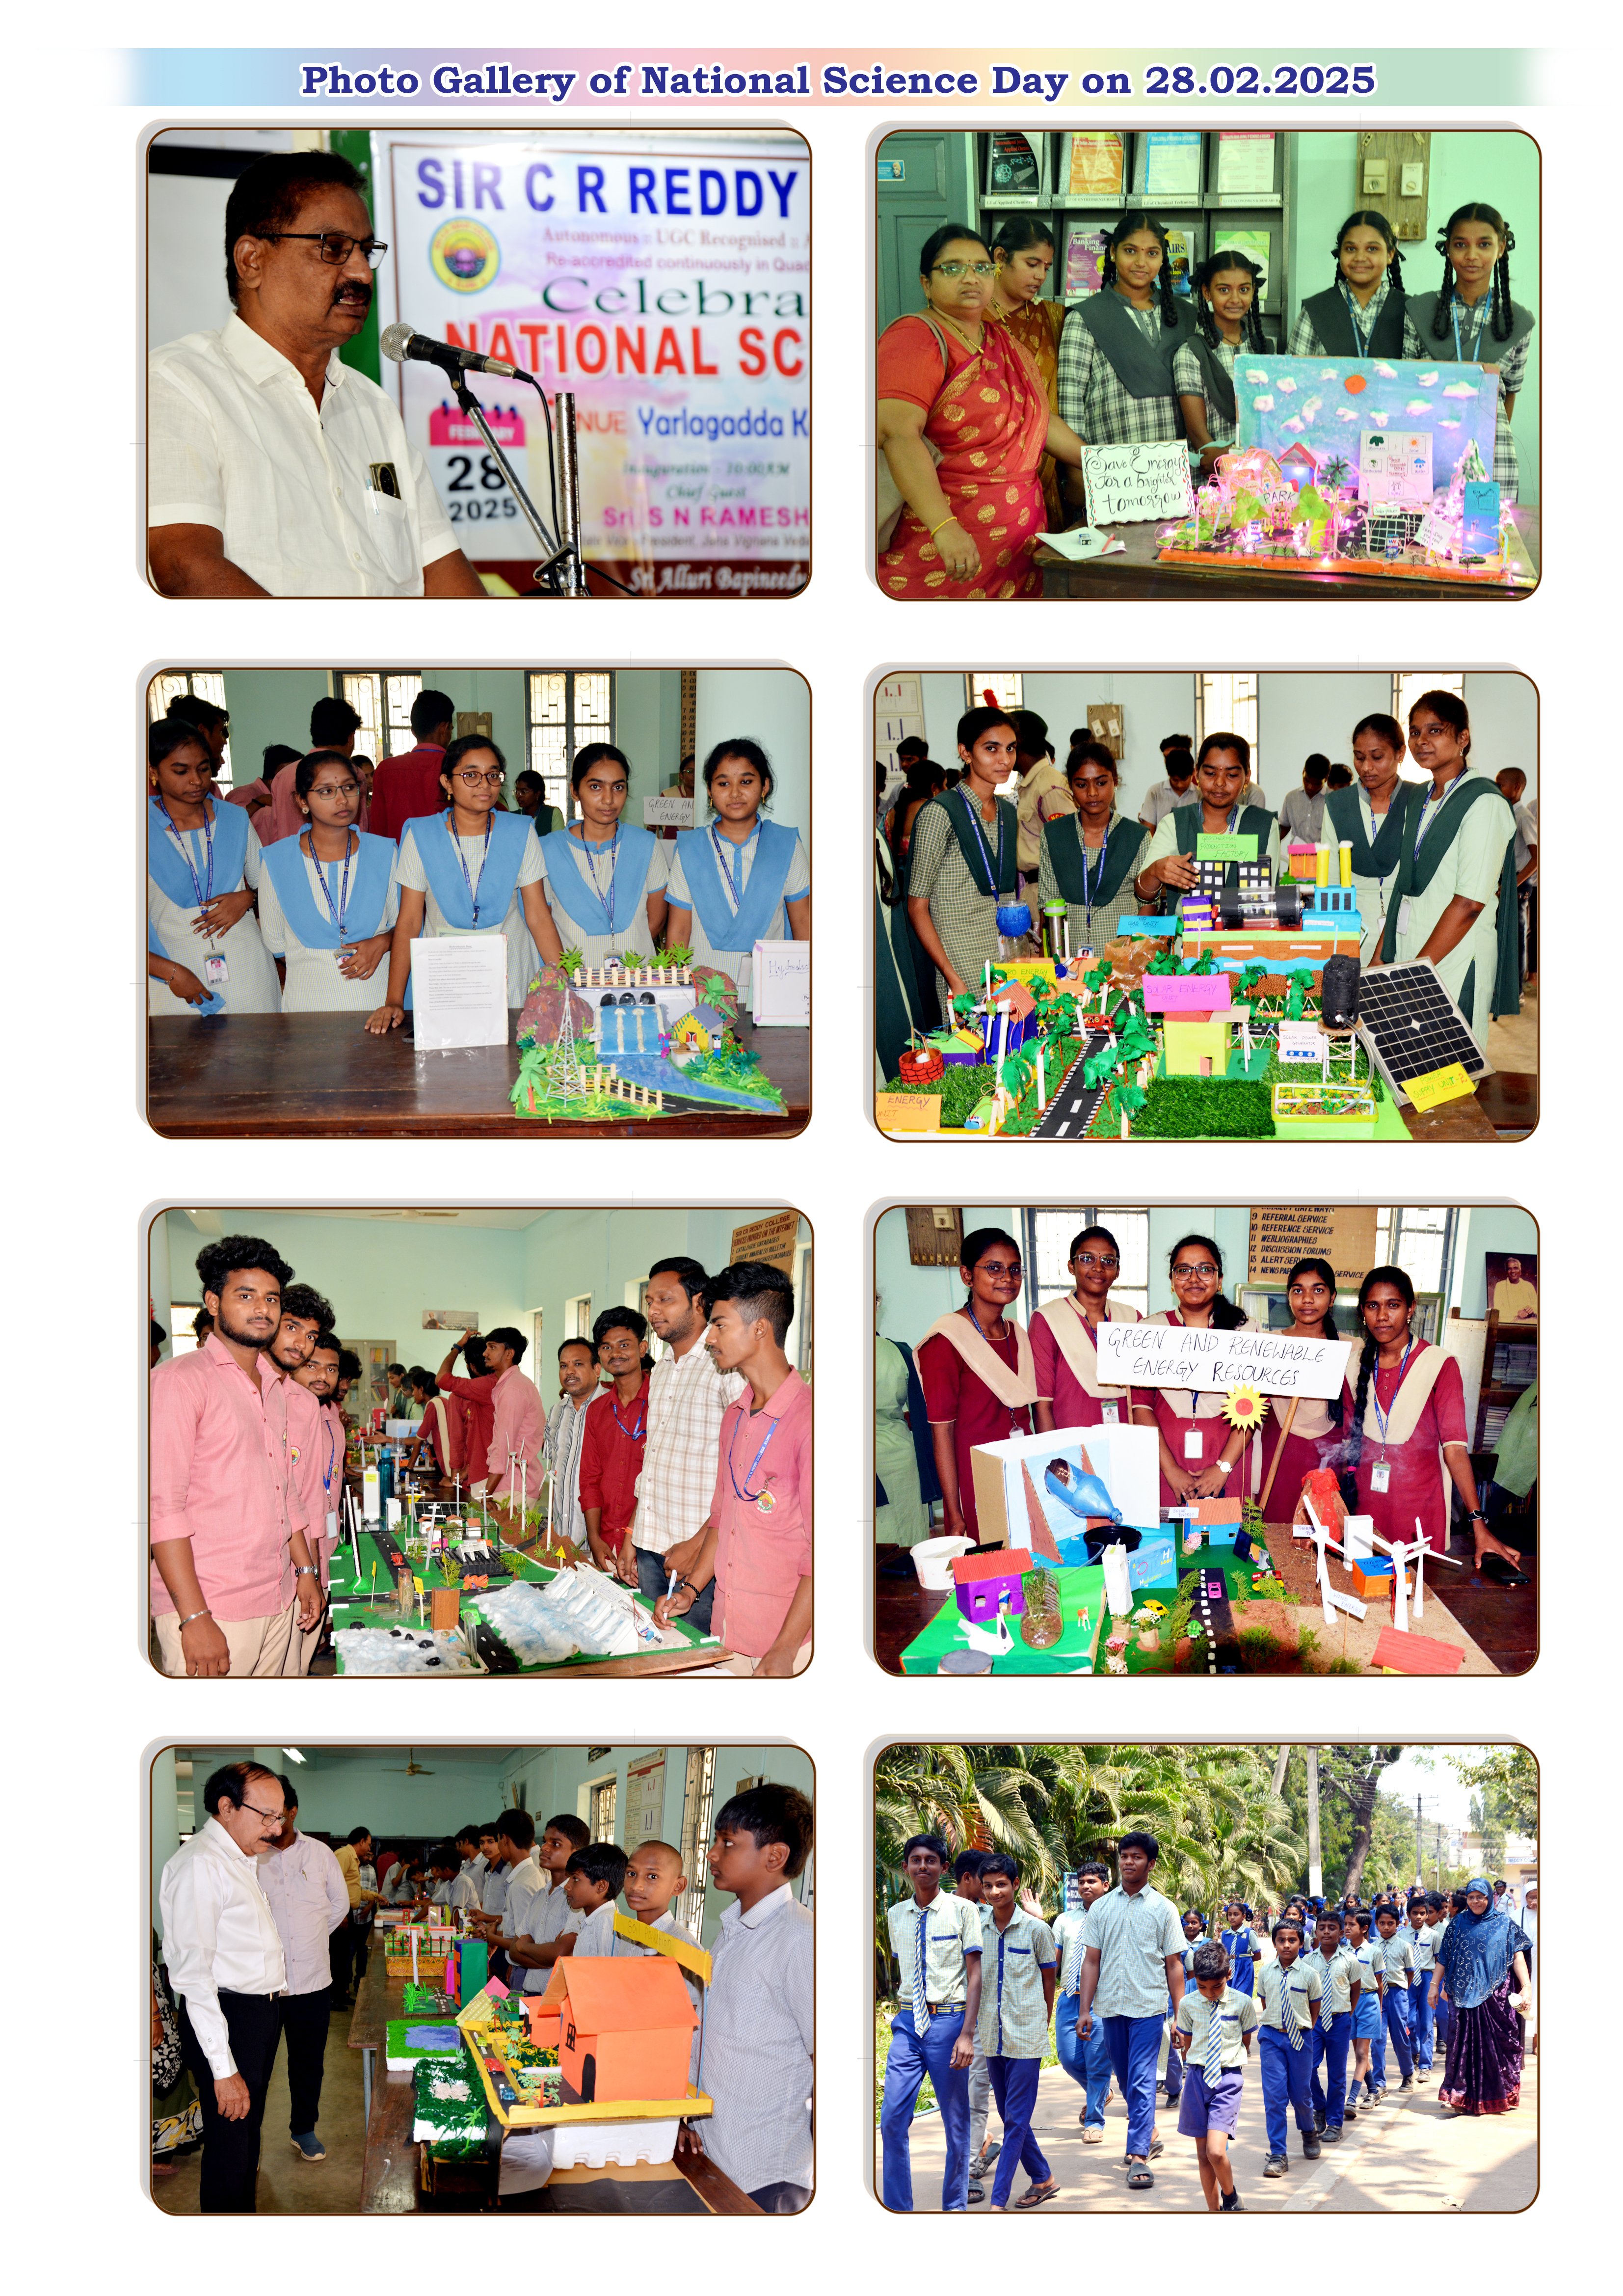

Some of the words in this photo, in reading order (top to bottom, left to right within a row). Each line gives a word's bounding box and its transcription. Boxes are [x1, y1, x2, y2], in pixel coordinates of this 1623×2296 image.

[417, 157, 505, 210] SIR
[525, 163, 555, 212] C
[577, 165, 608, 214] R
[629, 166, 798, 219] REDDY
[543, 227, 639, 244] Autonomous
[657, 228, 695, 245] UGC
[700, 229, 786, 252] Recognised
[1072, 238, 1100, 246] Banking
[546, 251, 652, 270] Re-accredited
[657, 255, 751, 275] continuously
[756, 257, 769, 271] in
[446, 322, 718, 375] NATIONAL
[739, 326, 804, 378] SC
[639, 405, 785, 441] Yarlagadda
[1086, 448, 1128, 475] Save
[1129, 447, 1183, 478] Energy
[448, 454, 507, 491] 28
[666, 482, 705, 501] Chief
[1137, 475, 1178, 494] brighter
[1102, 490, 1181, 514] tomorrow
[1263, 490, 1296, 504] PARK
[449, 497, 518, 523] 2025
[649, 506, 664, 528] S
[674, 506, 691, 528] N
[701, 506, 810, 528] RAMESH
[648, 798, 676, 813] GREEN
[660, 811, 691, 824] ENERGY
[1199, 842, 1237, 851] PRODUCTION
[1213, 850, 1249, 860] FACTORY
[1021, 969, 1048, 977] ENERGY
[1146, 984, 1173, 994] SOLAR
[1179, 983, 1218, 996] ENERGY
[1420, 1070, 1442, 1085] POWER
[1413, 1083, 1437, 1100] SUPPLY
[887, 1095, 931, 1109] ENERGY
[749, 1223, 764, 1234] REDDY
[765, 1215, 791, 1228] COLLEGE
[1251, 1212, 1258, 1220] 9
[1261, 1213, 1297, 1222] REFERRAL
[1297, 1214, 1328, 1223] SERVICE
[775, 1220, 796, 1234] INTERNET
[1261, 1223, 1302, 1233] REFERENCE
[1302, 1225, 1335, 1235] SERVICE
[736, 1243, 756, 1254] CATALOGUE
[756, 1236, 780, 1247] DATABASES
[1261, 1234, 1318, 1244] WEBLIOGRAPHIES
[768, 1243, 787, 1253] BULLETIN
[1260, 1244, 1302, 1254] DISCUSSION
[1303, 1246, 1332, 1256] FORUMS
[1260, 1255, 1284, 1264] ALERT
[1334, 1270, 1365, 1279] SERVICE
[1108, 1327, 1168, 1358] GREEN
[1180, 1332, 1219, 1354] AND
[1228, 1336, 1326, 1363] RENEWABLE
[1133, 1357, 1199, 1382] ENERGY
[1212, 1361, 1300, 1386] RESOURCES
[756, 1446, 766, 1461] COLLEGE
[1163, 1548, 1171, 1560] H
[1139, 1573, 1162, 1586] Hydrogen
[595, 1580, 622, 1603] Electricity
[1333, 1592, 1349, 1602] WIND
[1340, 1600, 1363, 1615] ENERGY
[627, 1919, 640, 1938] Soil
